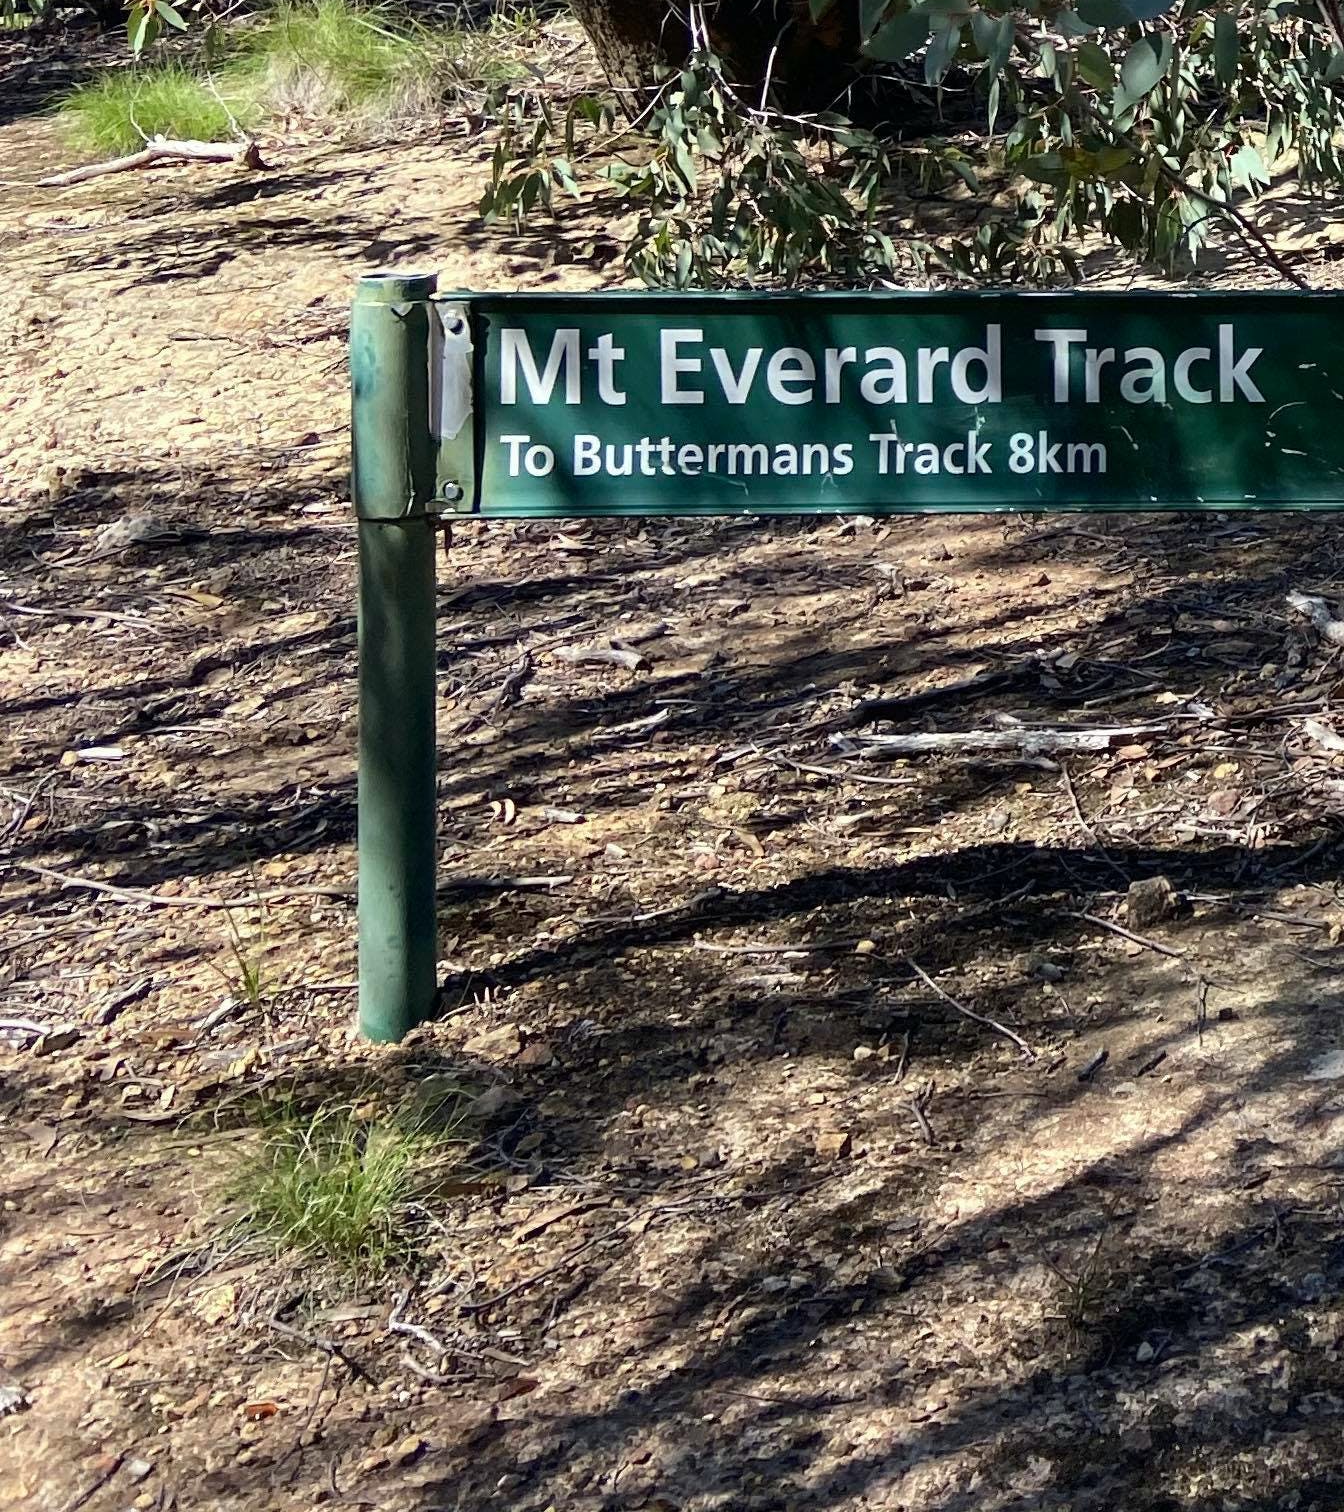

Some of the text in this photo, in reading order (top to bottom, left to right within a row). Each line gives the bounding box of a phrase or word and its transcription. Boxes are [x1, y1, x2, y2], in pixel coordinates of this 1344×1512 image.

[499, 323, 1266, 406] Mt Everard Track
[500, 430, 1107, 478] To Buttermans Track 8km
